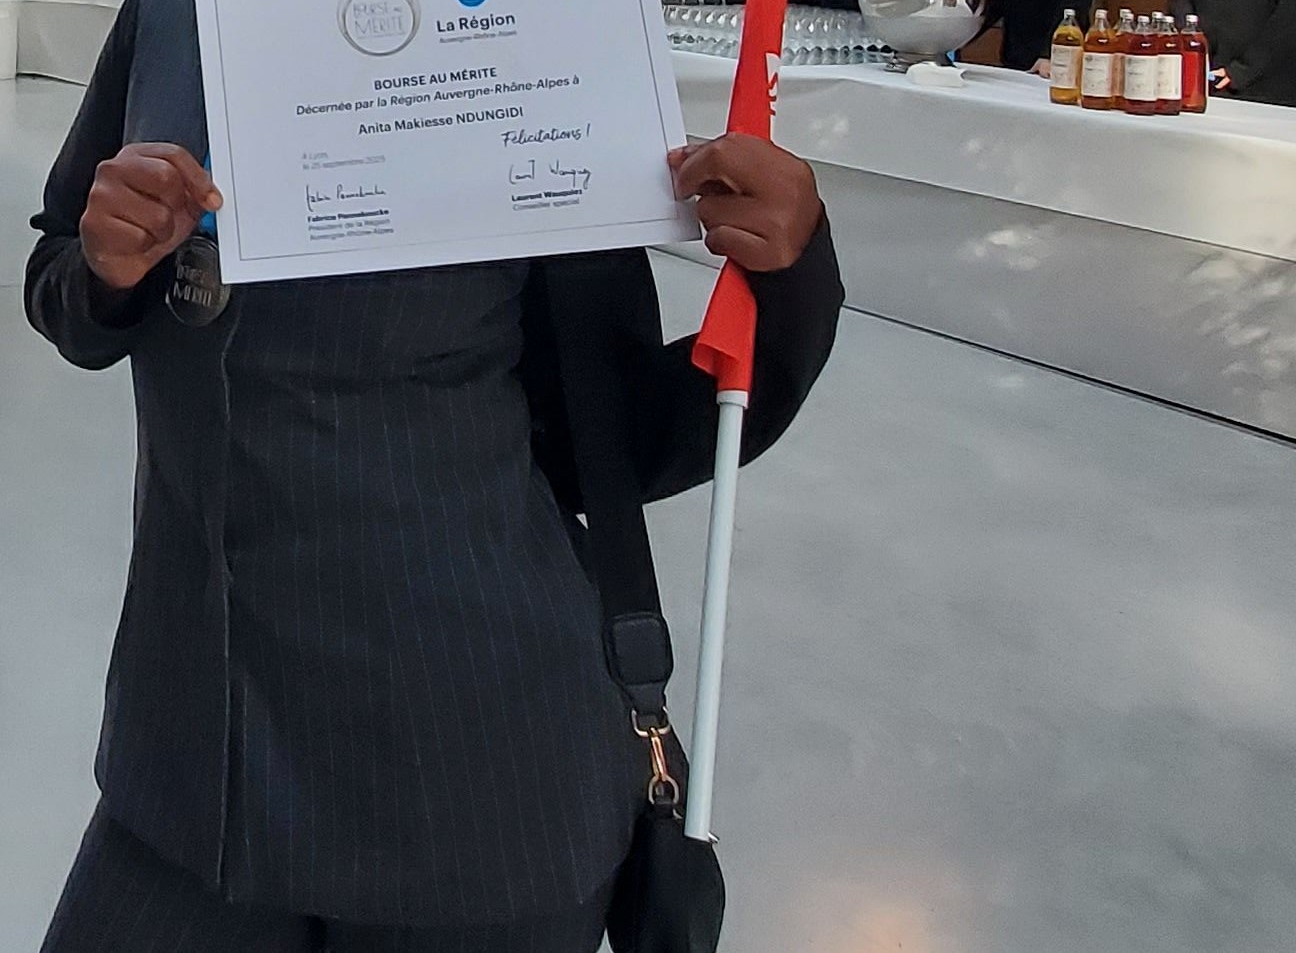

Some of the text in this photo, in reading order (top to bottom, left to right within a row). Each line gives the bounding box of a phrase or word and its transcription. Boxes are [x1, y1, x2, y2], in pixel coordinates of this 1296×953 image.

[436, 13, 516, 33] La Région
[374, 67, 498, 91] BOURSE AU MÉRITE
[296, 74, 580, 115] Décernée par la Région Auvergne-Rhône-Alpes à
[358, 106, 524, 135] Anita Makiesse NDUNGIDI
